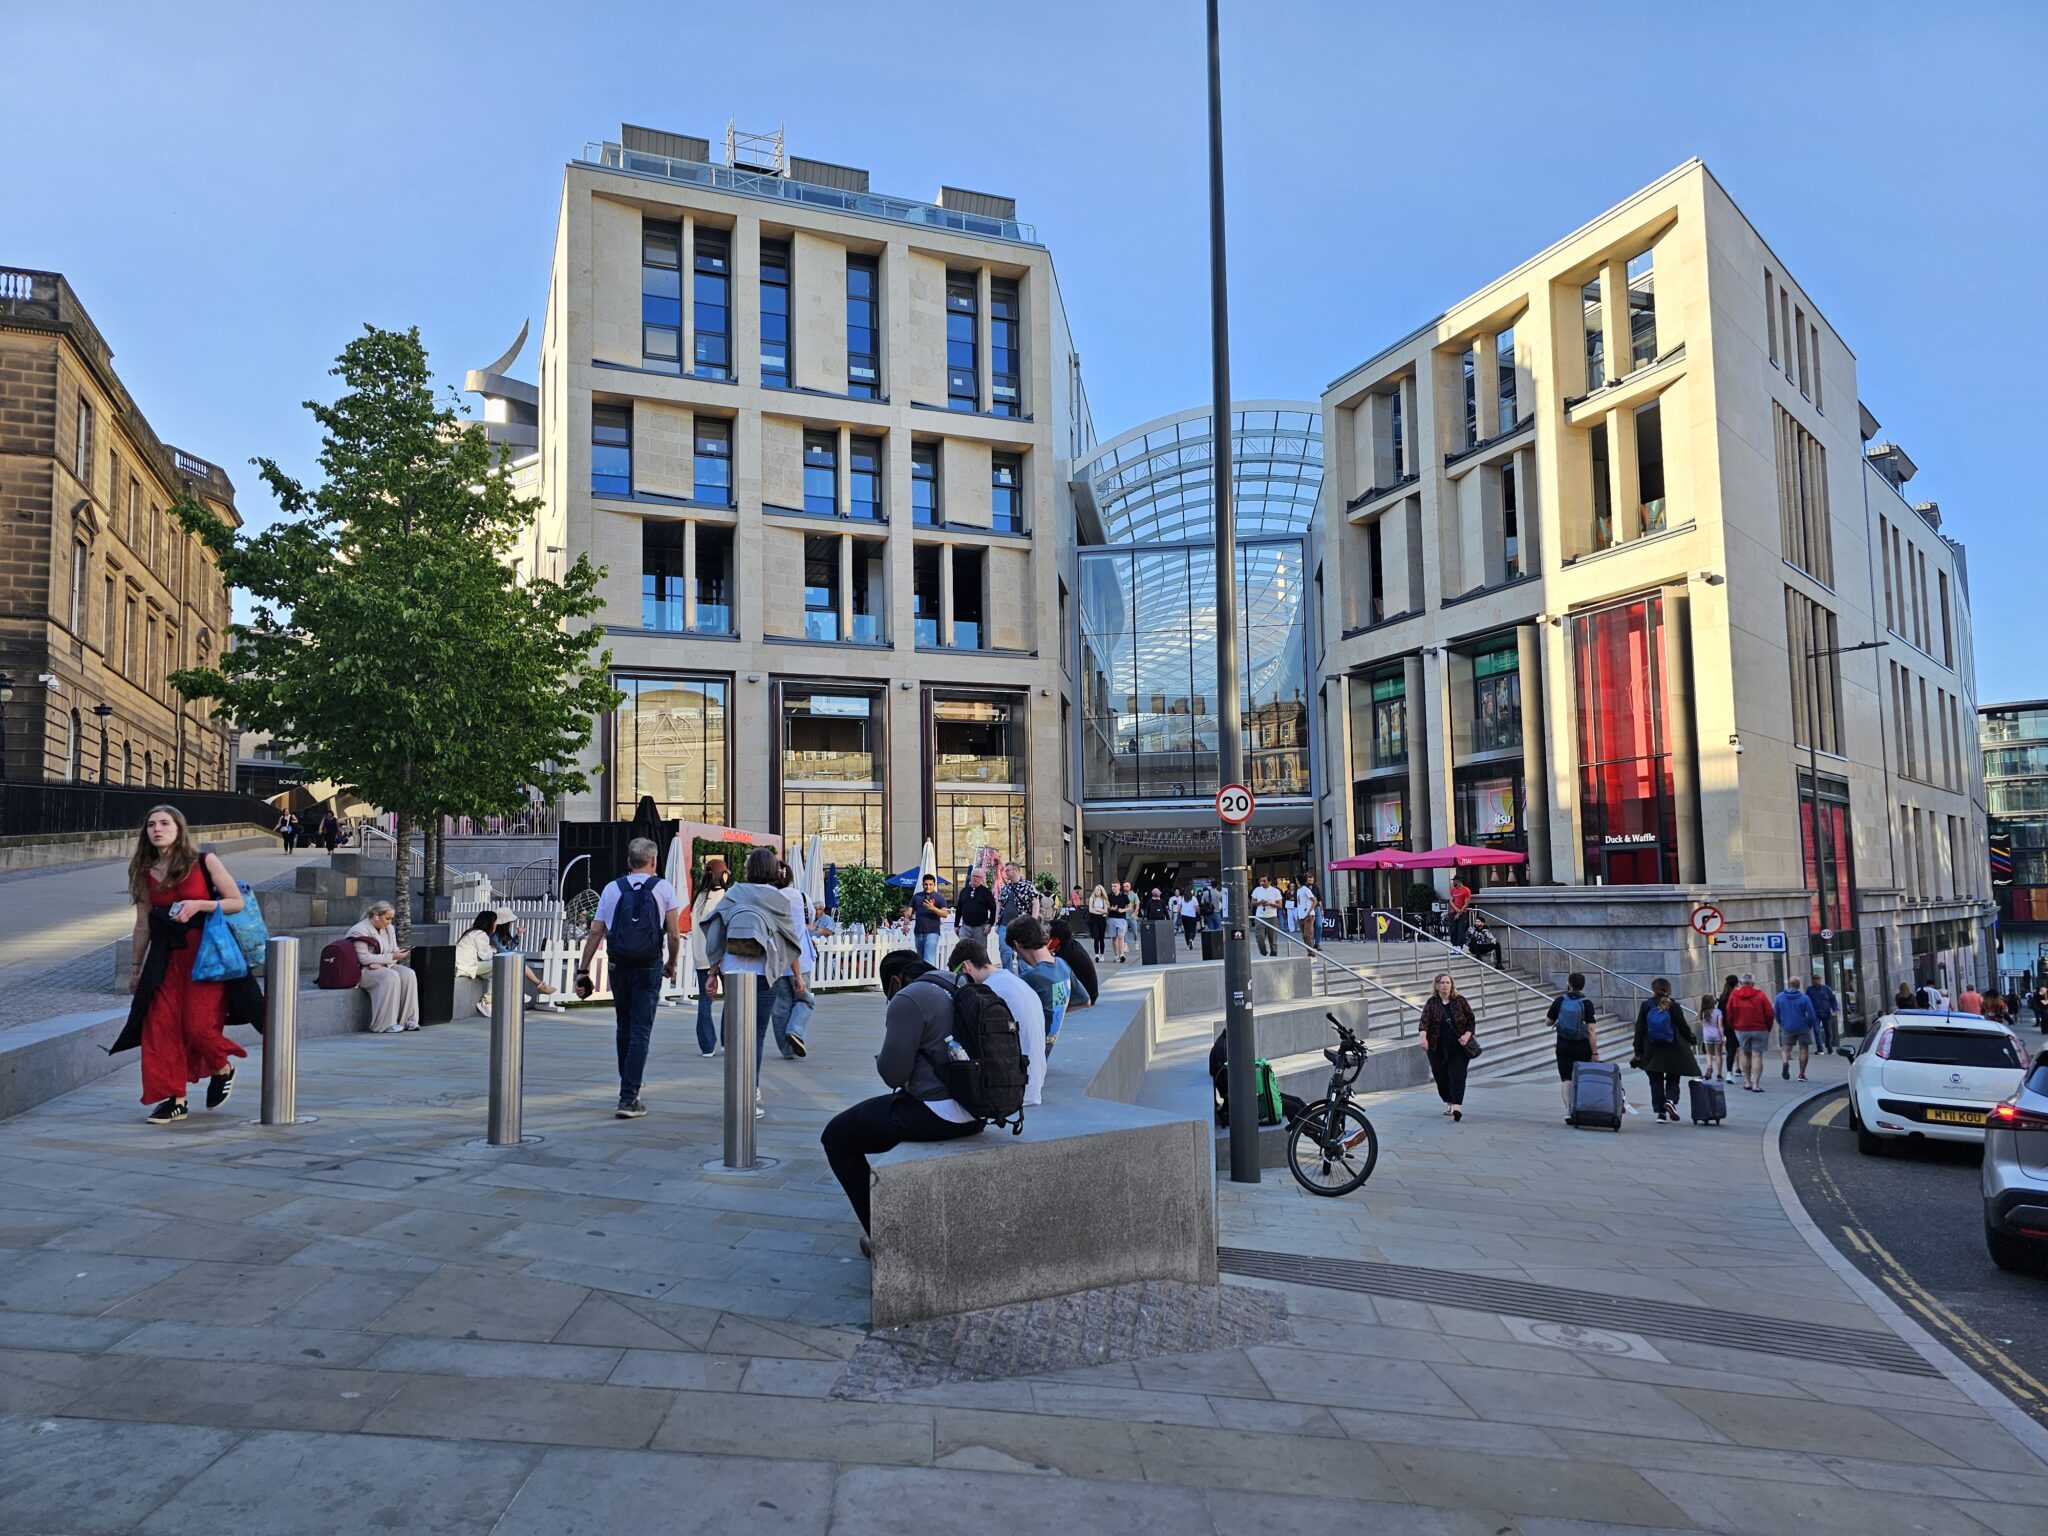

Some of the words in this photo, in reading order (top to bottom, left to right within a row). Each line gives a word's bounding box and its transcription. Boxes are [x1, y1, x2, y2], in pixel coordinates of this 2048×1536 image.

[1222, 795, 1249, 812] 20
[803, 834, 861, 842] STRBUCKS
[1605, 834, 1623, 844] Duck
[1624, 834, 1631, 843] &
[1631, 832, 1656, 843] Waffle
[1740, 934, 1766, 942] James
[1959, 1112, 1981, 1123] KOU
